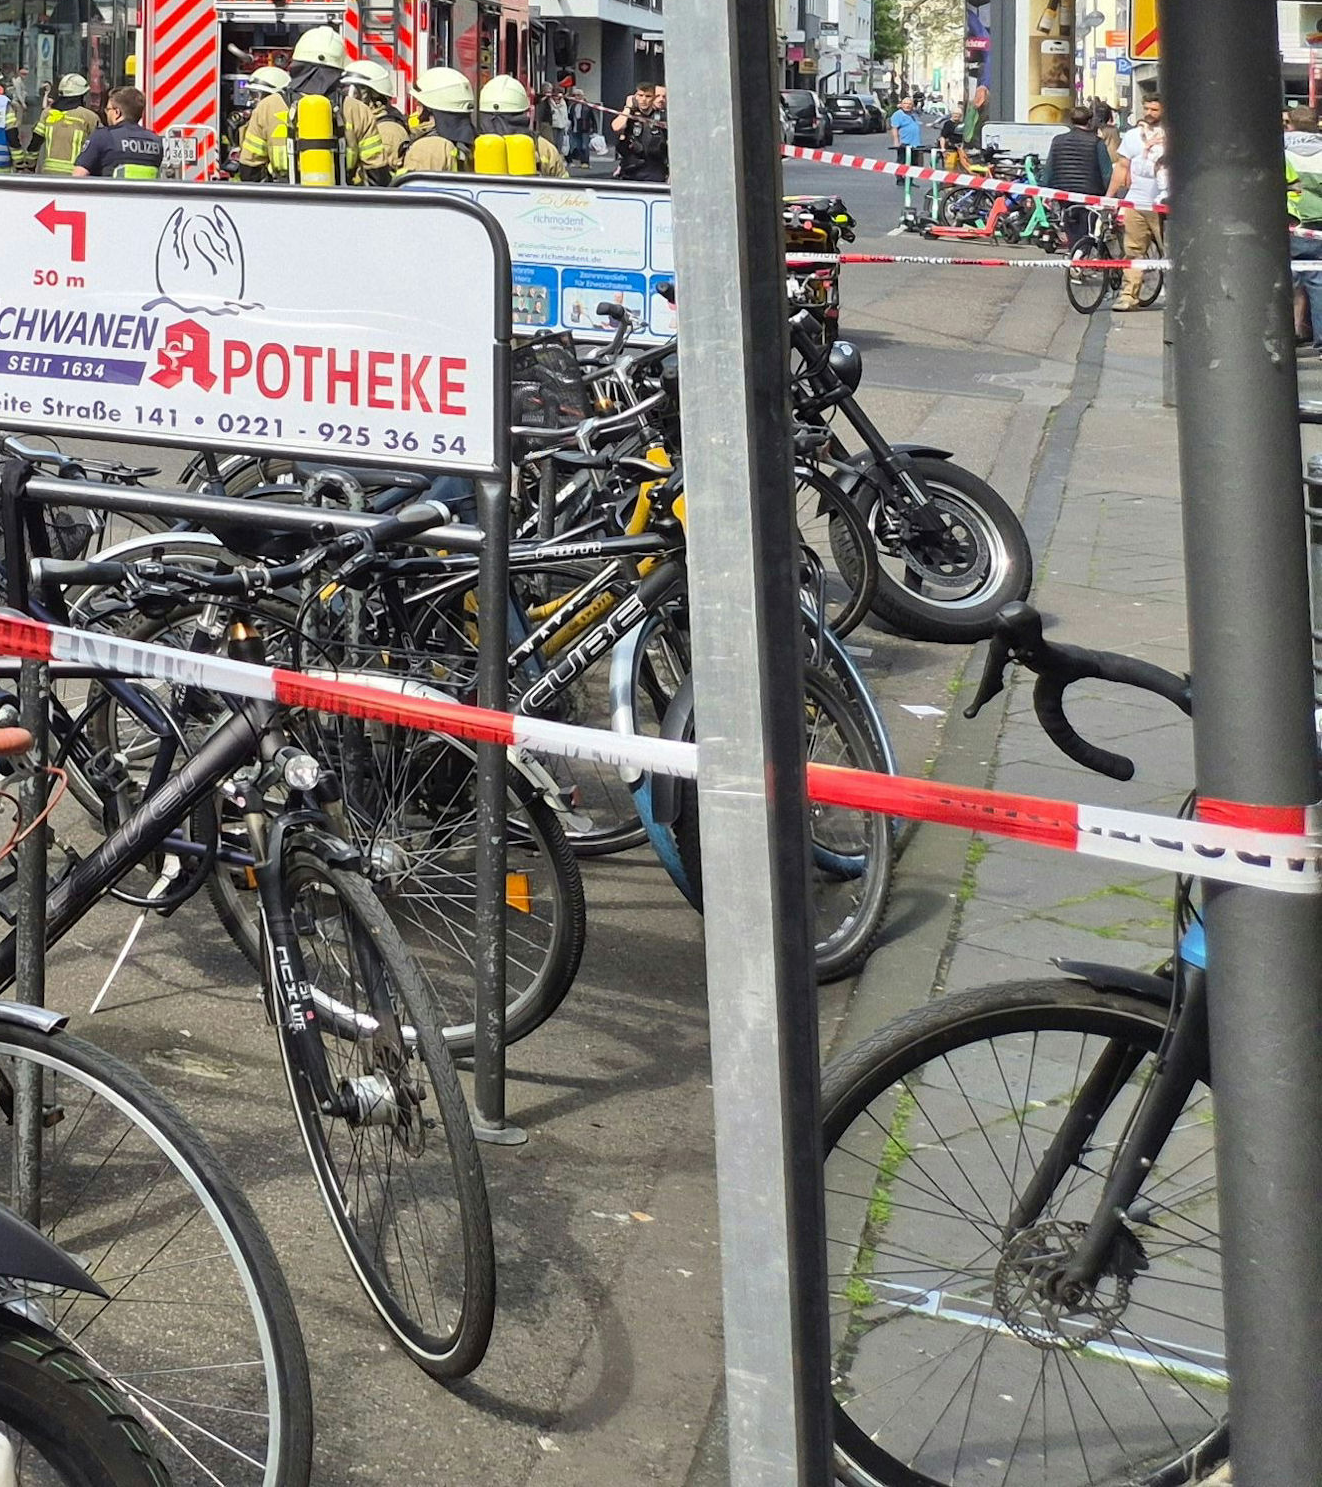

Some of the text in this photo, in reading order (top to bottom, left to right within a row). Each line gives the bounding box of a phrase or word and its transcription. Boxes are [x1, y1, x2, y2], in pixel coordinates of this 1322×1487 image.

[33, 269, 86, 289] 50 m
[7, 355, 106, 380] SEIT 1634
[43, 396, 122, 424] Straße
[135, 405, 179, 427] 141
[218, 413, 283, 439] 0221
[318, 422, 371, 448] 925
[384, 428, 419, 452] 36
[431, 432, 467, 457] 54
[521, 593, 647, 715] CUBE
